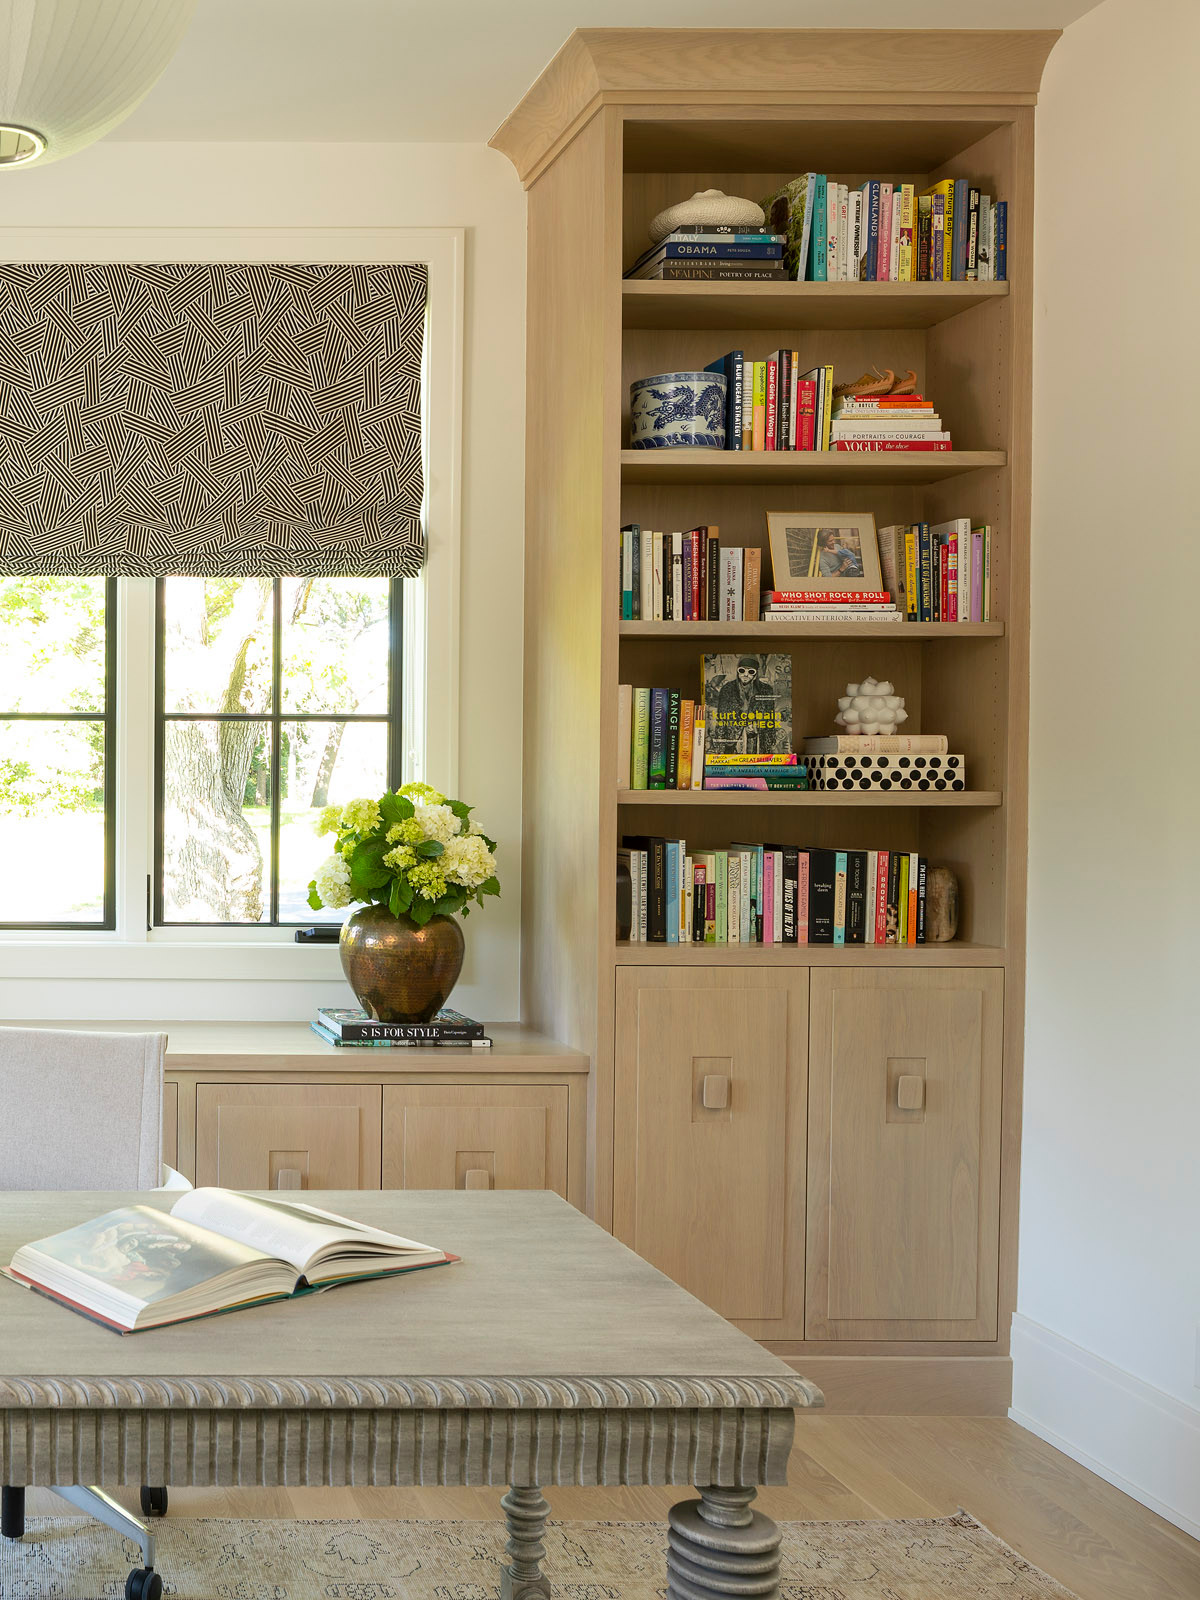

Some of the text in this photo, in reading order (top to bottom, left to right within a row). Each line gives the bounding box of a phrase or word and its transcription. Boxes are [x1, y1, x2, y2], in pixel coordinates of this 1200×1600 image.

[871, 183, 880, 237] CLANLANDS
[945, 183, 954, 237] Achtung Baby
[678, 246, 717, 254] OBAMA
[767, 415, 775, 437] Wong
[844, 442, 883, 452] VOGUE
[922, 549, 930, 558] THE
[922, 559, 930, 569] ART
[922, 577, 930, 609] ACHIEVEMENT
[638, 691, 647, 747] LUCINDA RILEY
[670, 693, 679, 731] RANGE
[712, 709, 782, 720] kurt cobain
[654, 692, 663, 749] LUCINDA RILEY
[784, 879, 794, 903] MOVIES
[784, 903, 794, 912] OF
[784, 913, 794, 924] THE
[361, 1028, 440, 1038] S IS FOR STYLE
